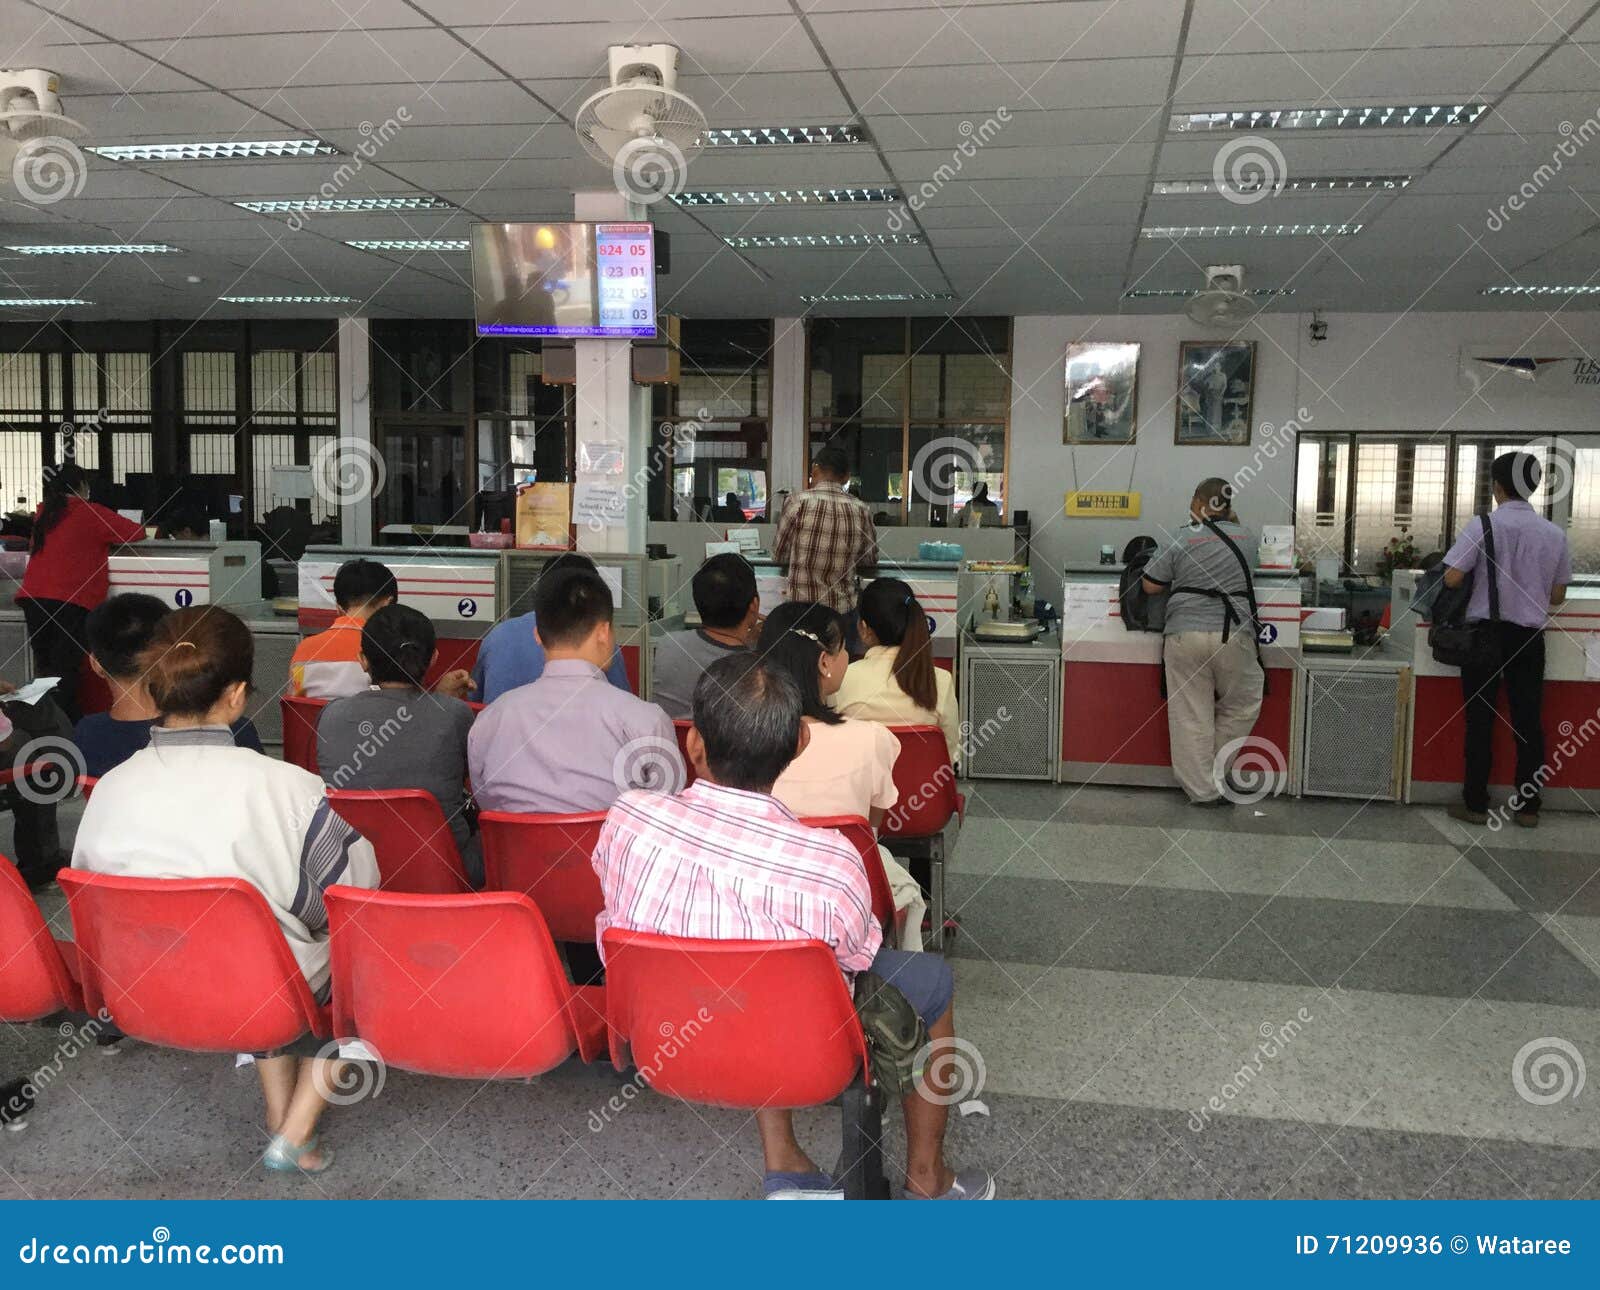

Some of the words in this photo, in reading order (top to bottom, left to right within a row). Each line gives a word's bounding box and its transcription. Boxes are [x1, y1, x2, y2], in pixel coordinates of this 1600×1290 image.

[599, 245, 623, 256] 824
[630, 245, 646, 256] 05
[630, 267, 645, 277] 01
[632, 309, 648, 320] 03
[461, 599, 473, 616] 2
[1259, 625, 1272, 642] 4
